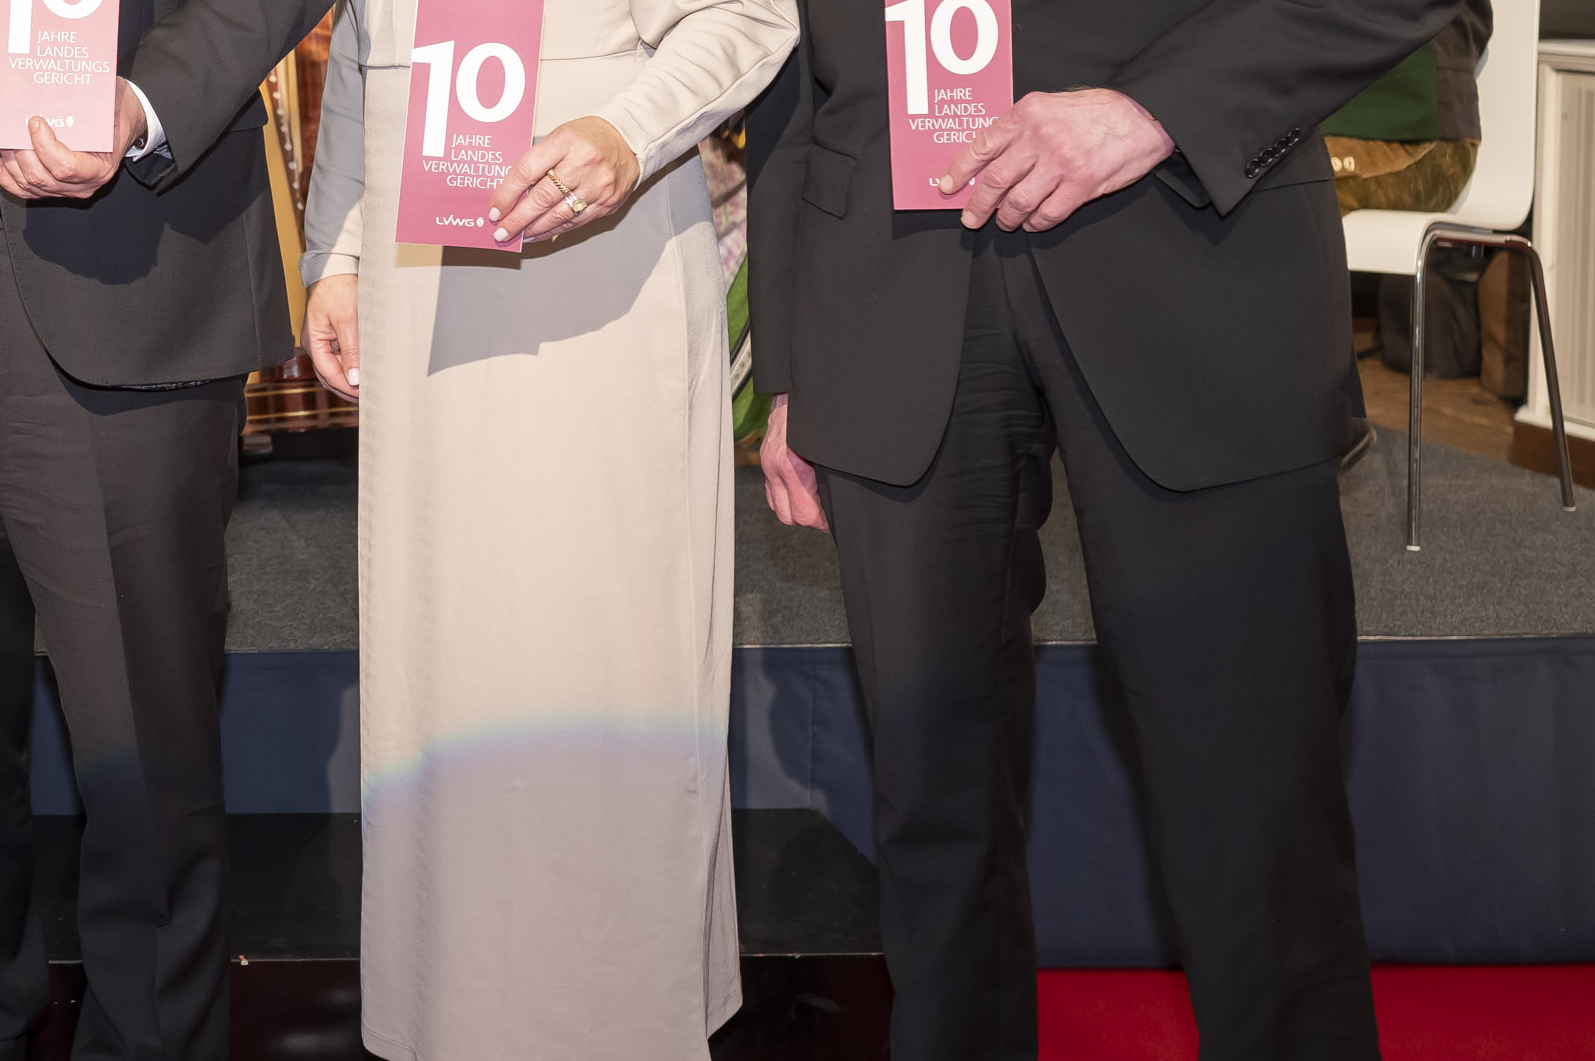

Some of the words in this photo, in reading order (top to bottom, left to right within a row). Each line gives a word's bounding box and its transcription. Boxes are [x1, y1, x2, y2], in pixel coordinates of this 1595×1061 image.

[37, 30, 77, 43] JAHRE
[37, 45, 89, 58] LANDES
[9, 57, 110, 73] VERWALTUNGS
[33, 71, 92, 85] GERICHT
[412, 40, 526, 158] 10
[934, 88, 973, 103] JAHRE
[934, 103, 986, 116] LANDES
[909, 116, 999, 131] VERWALTUN
[451, 134, 492, 148] JAHRE
[451, 149, 503, 163] LANDES
[422, 160, 513, 177] VERWALTUN
